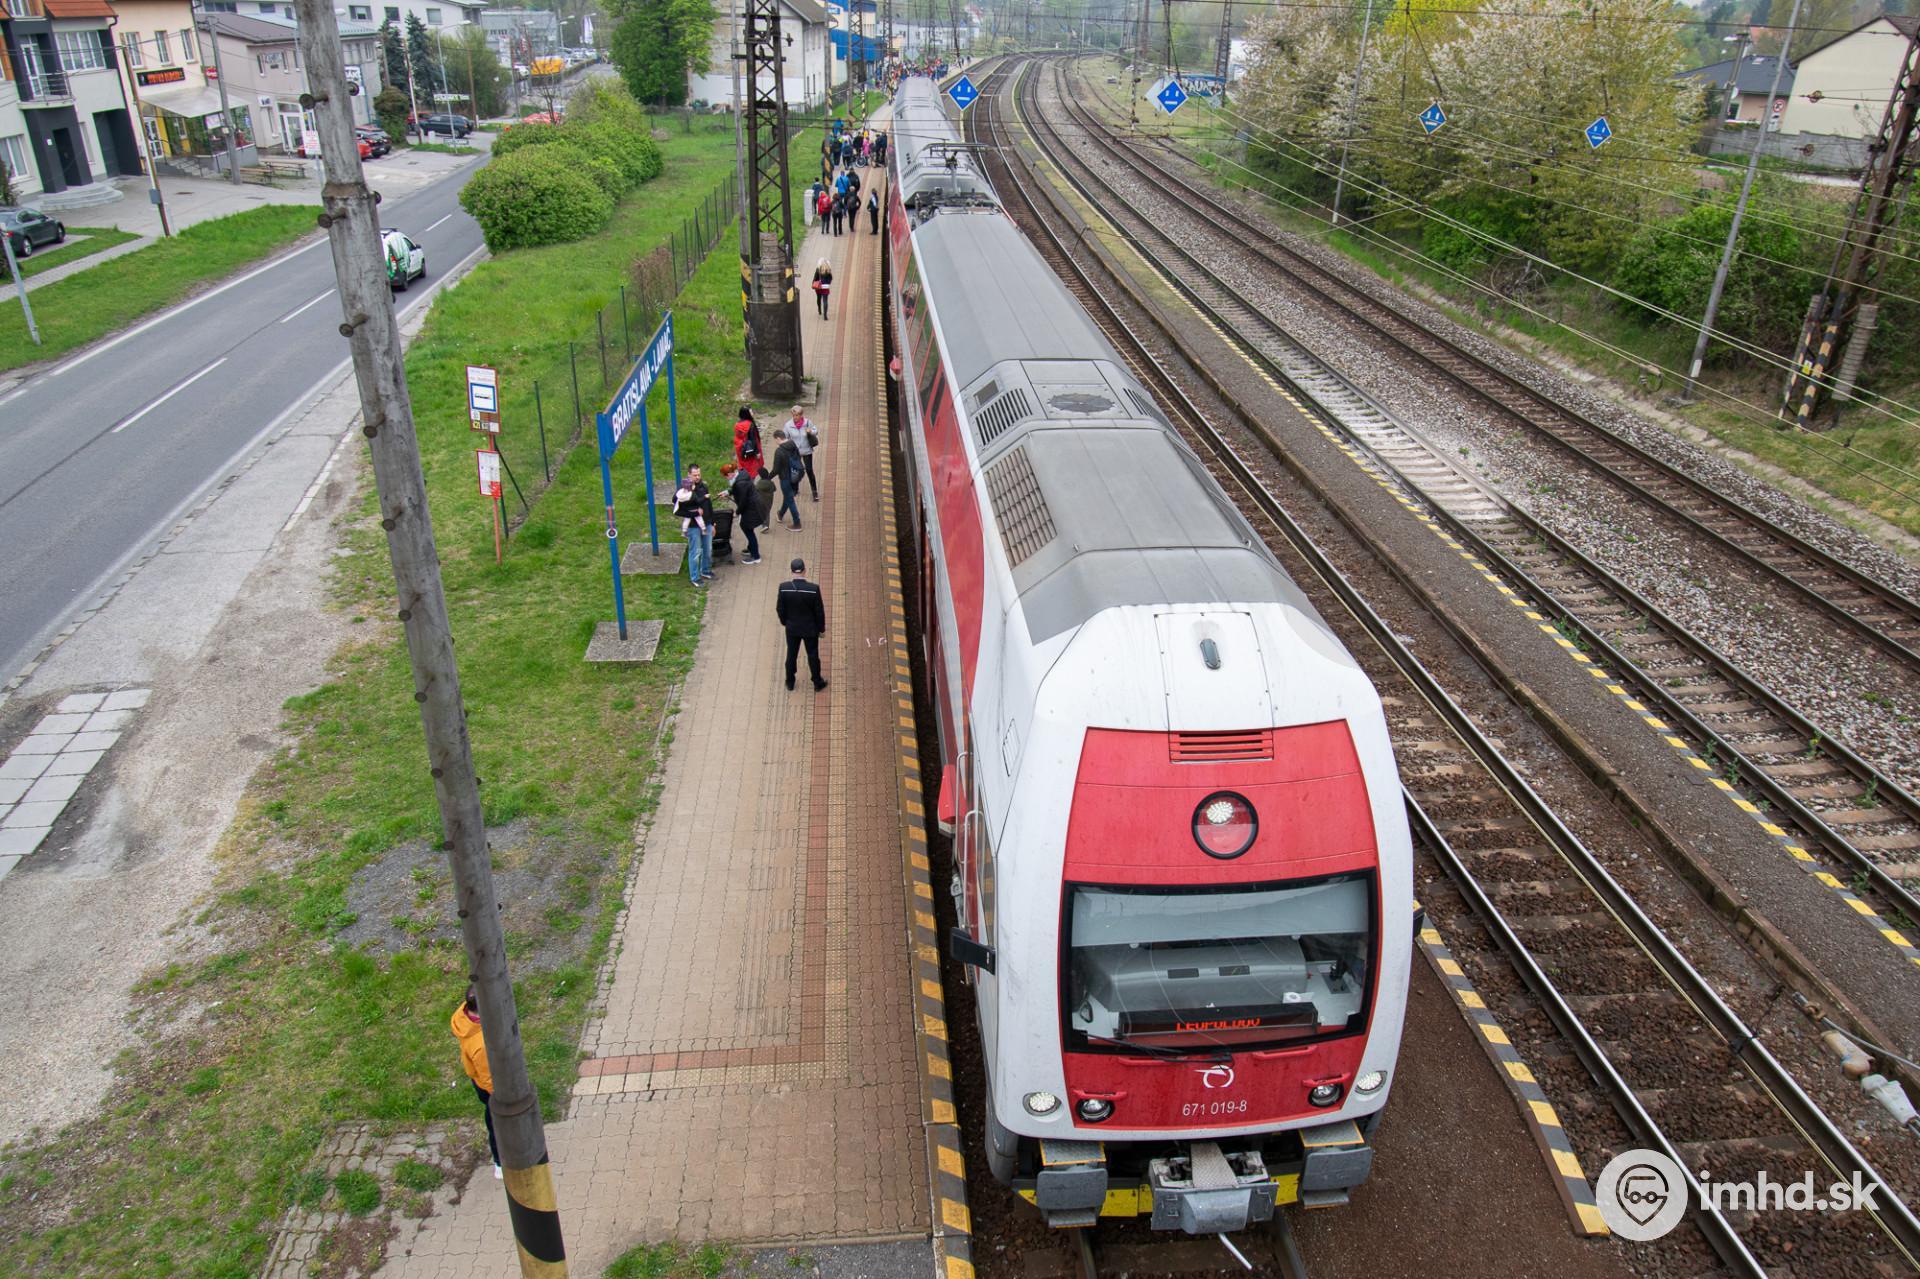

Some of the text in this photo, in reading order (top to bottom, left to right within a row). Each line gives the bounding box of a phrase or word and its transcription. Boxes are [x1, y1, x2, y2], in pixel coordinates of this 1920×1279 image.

[612, 360, 652, 443] BRATISLAVA
[1182, 1100, 1248, 1117] 671 019-8
